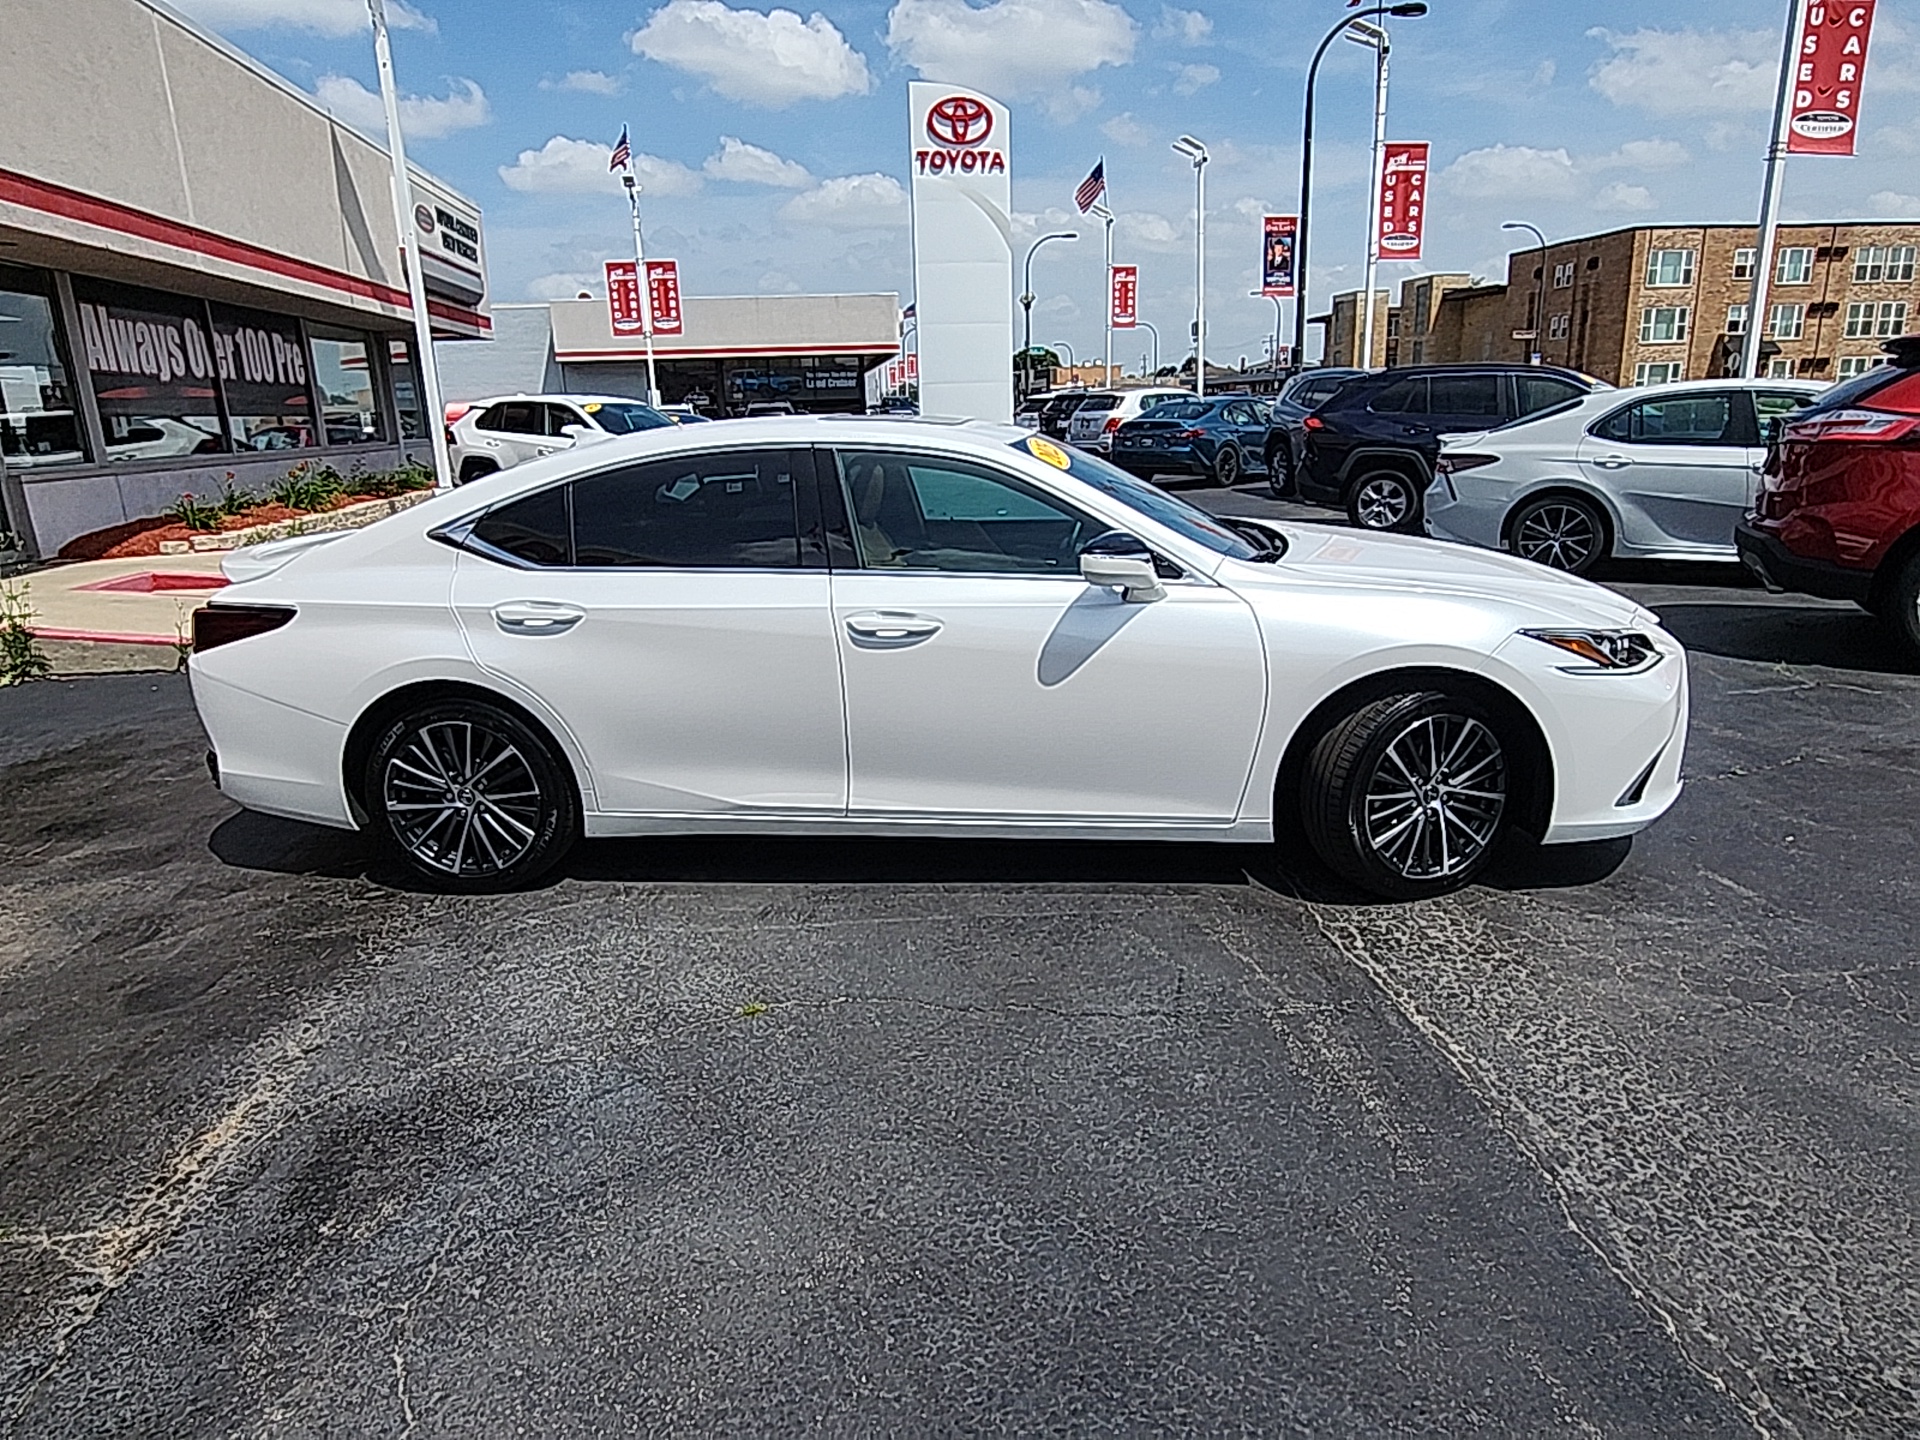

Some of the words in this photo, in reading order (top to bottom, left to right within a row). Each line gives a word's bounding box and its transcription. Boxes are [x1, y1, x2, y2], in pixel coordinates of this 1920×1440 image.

[1795, 6, 1825, 109] USED
[1835, 7, 1866, 109] CARS
[915, 149, 1005, 175] TOYOTA
[1383, 174, 1397, 233] USED
[1408, 173, 1422, 233] CARS
[610, 281, 622, 319] USED
[627, 281, 638, 319] CARS
[651, 280, 662, 317] USED
[667, 280, 678, 317] CARS
[79, 303, 186, 382] Always
[234, 326, 274, 383] 100
[271, 332, 306, 385] Pre
